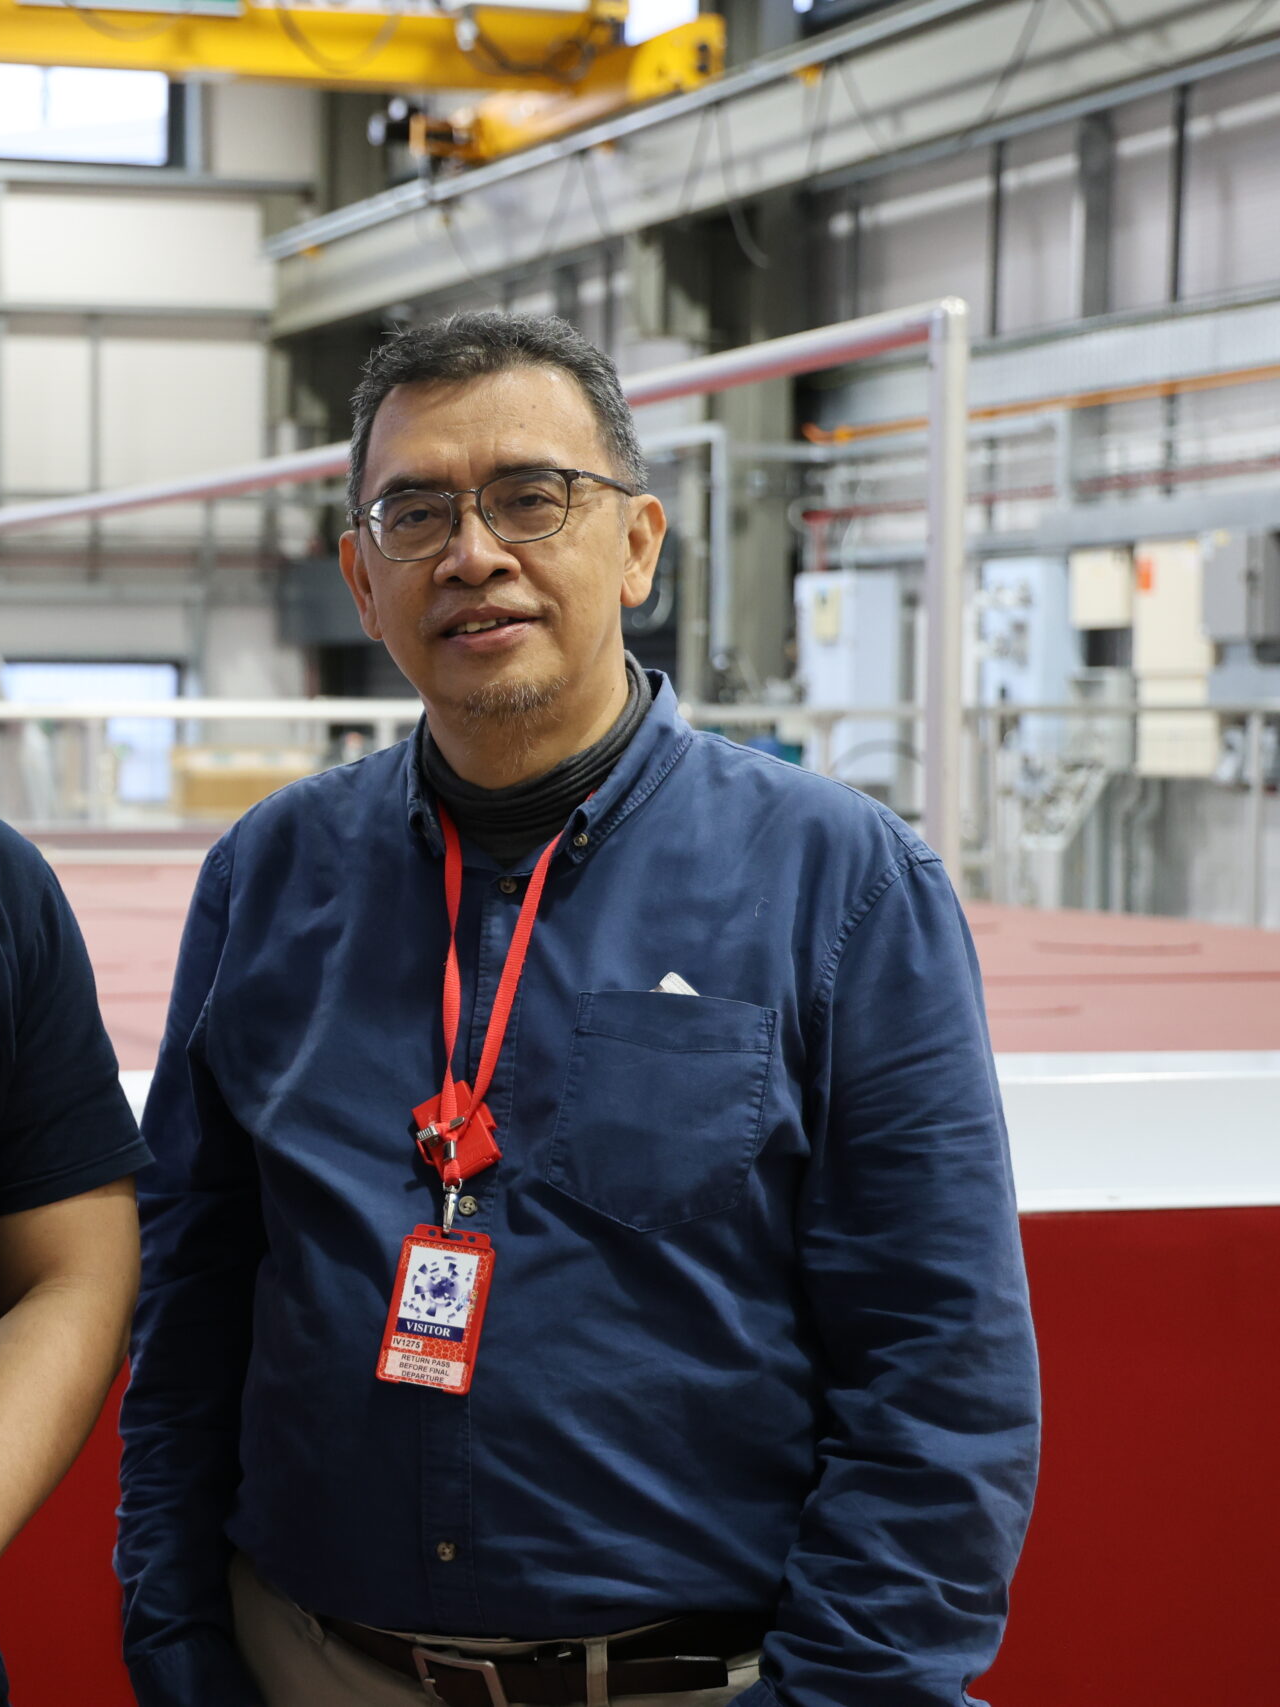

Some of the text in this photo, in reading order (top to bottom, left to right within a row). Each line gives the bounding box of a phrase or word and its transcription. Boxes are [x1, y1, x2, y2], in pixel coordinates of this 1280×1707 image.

[406, 1321, 451, 1337] VISITOR
[392, 1337, 421, 1349] IV1275
[401, 1354, 451, 1368] RETURN PASS
[399, 1362, 450, 1376] BEFORE FINAL
[401, 1371, 445, 1383] DEPARTURE
